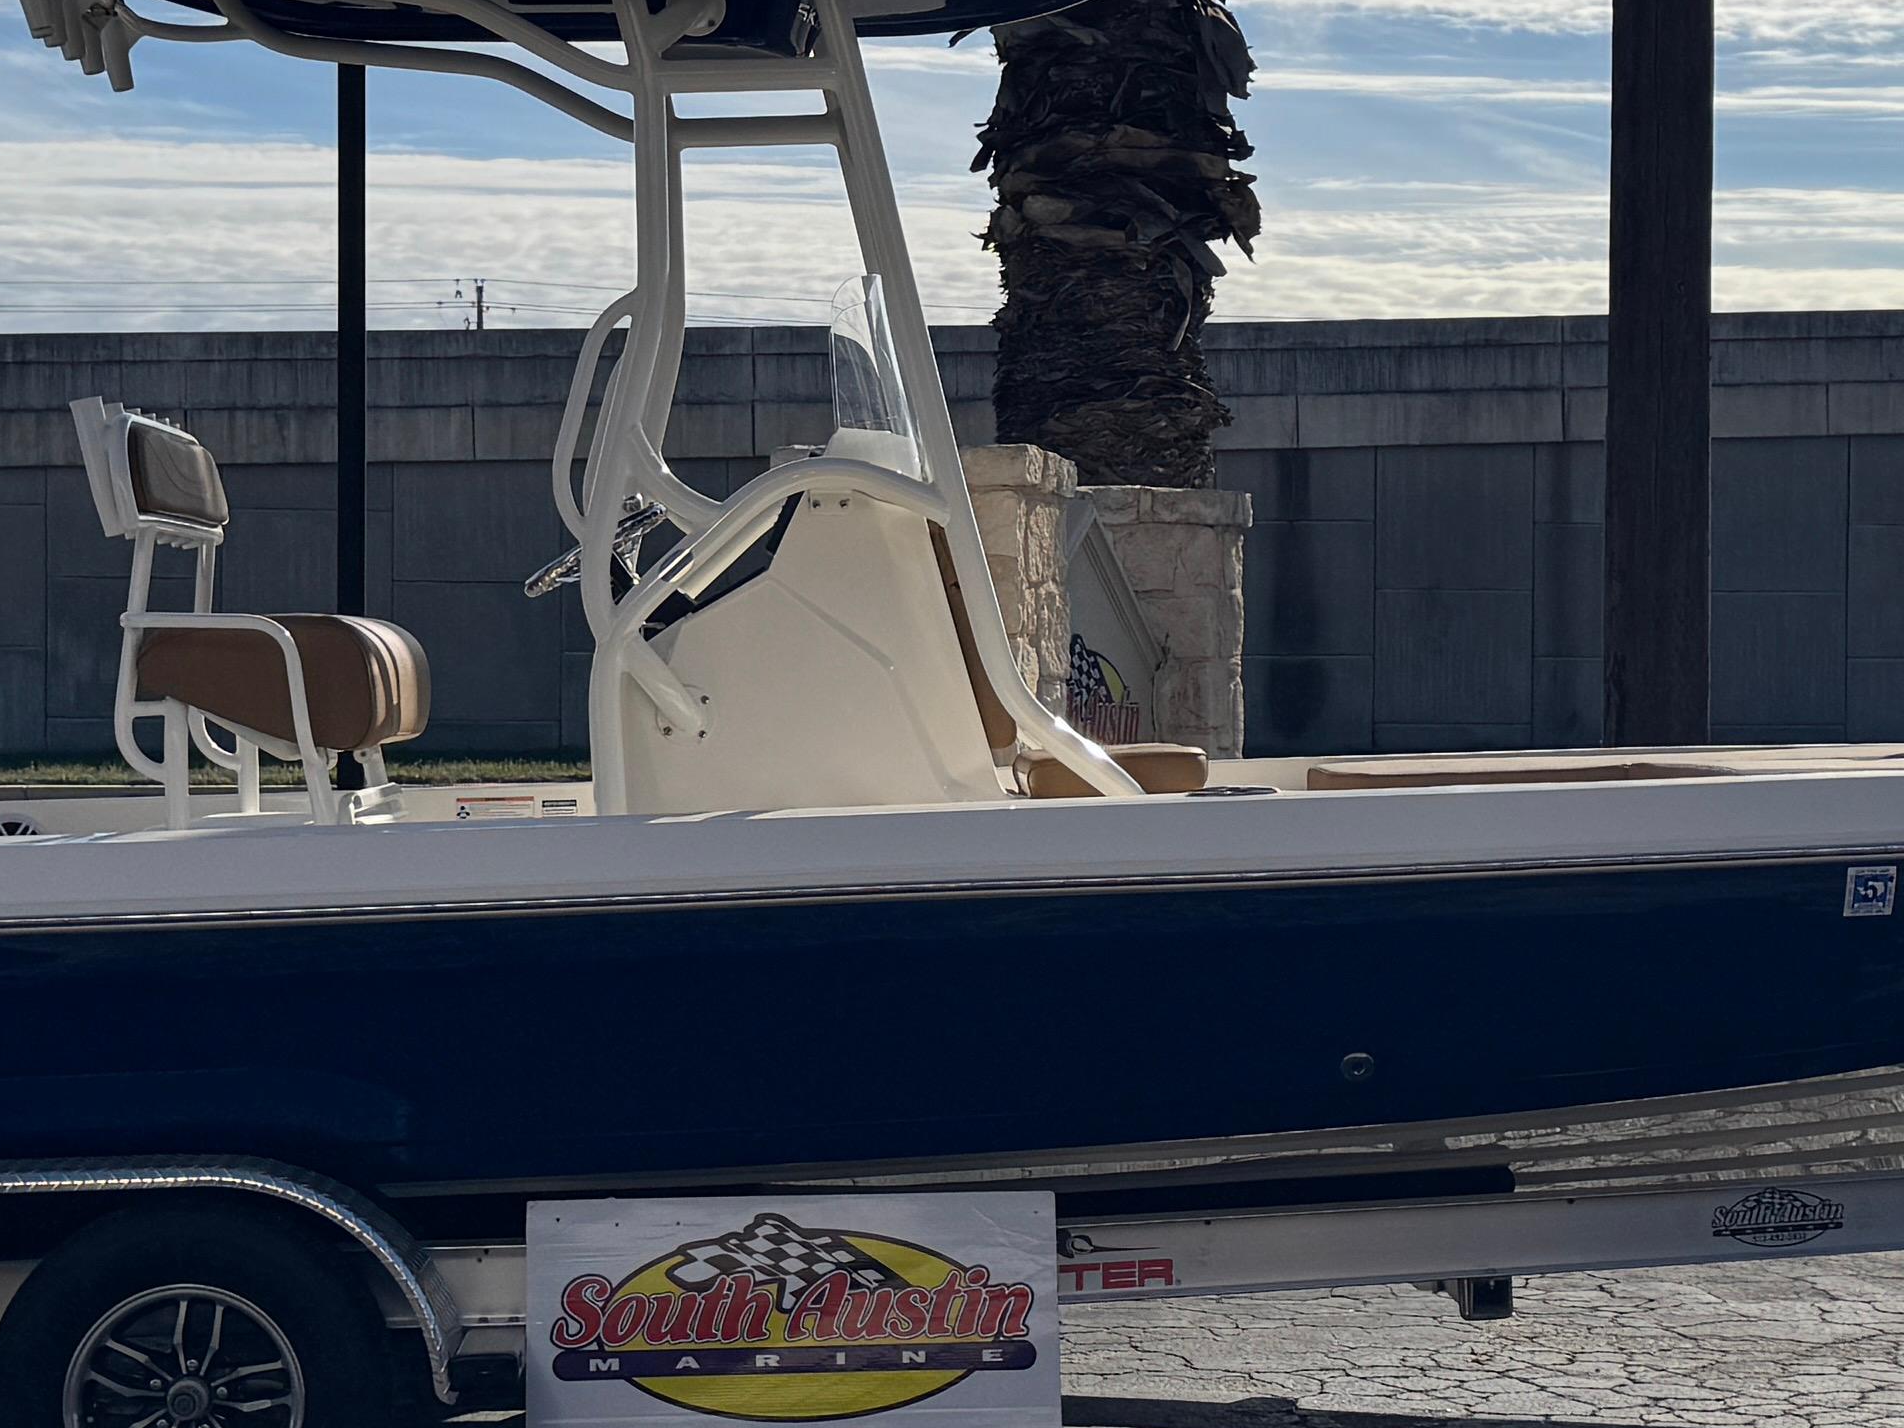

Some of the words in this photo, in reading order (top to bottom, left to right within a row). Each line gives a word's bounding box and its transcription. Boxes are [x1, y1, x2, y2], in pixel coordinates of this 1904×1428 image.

[551, 1272, 773, 1349] South
[784, 1264, 1034, 1343] Austin
[588, 1347, 1005, 1373] MARINE
